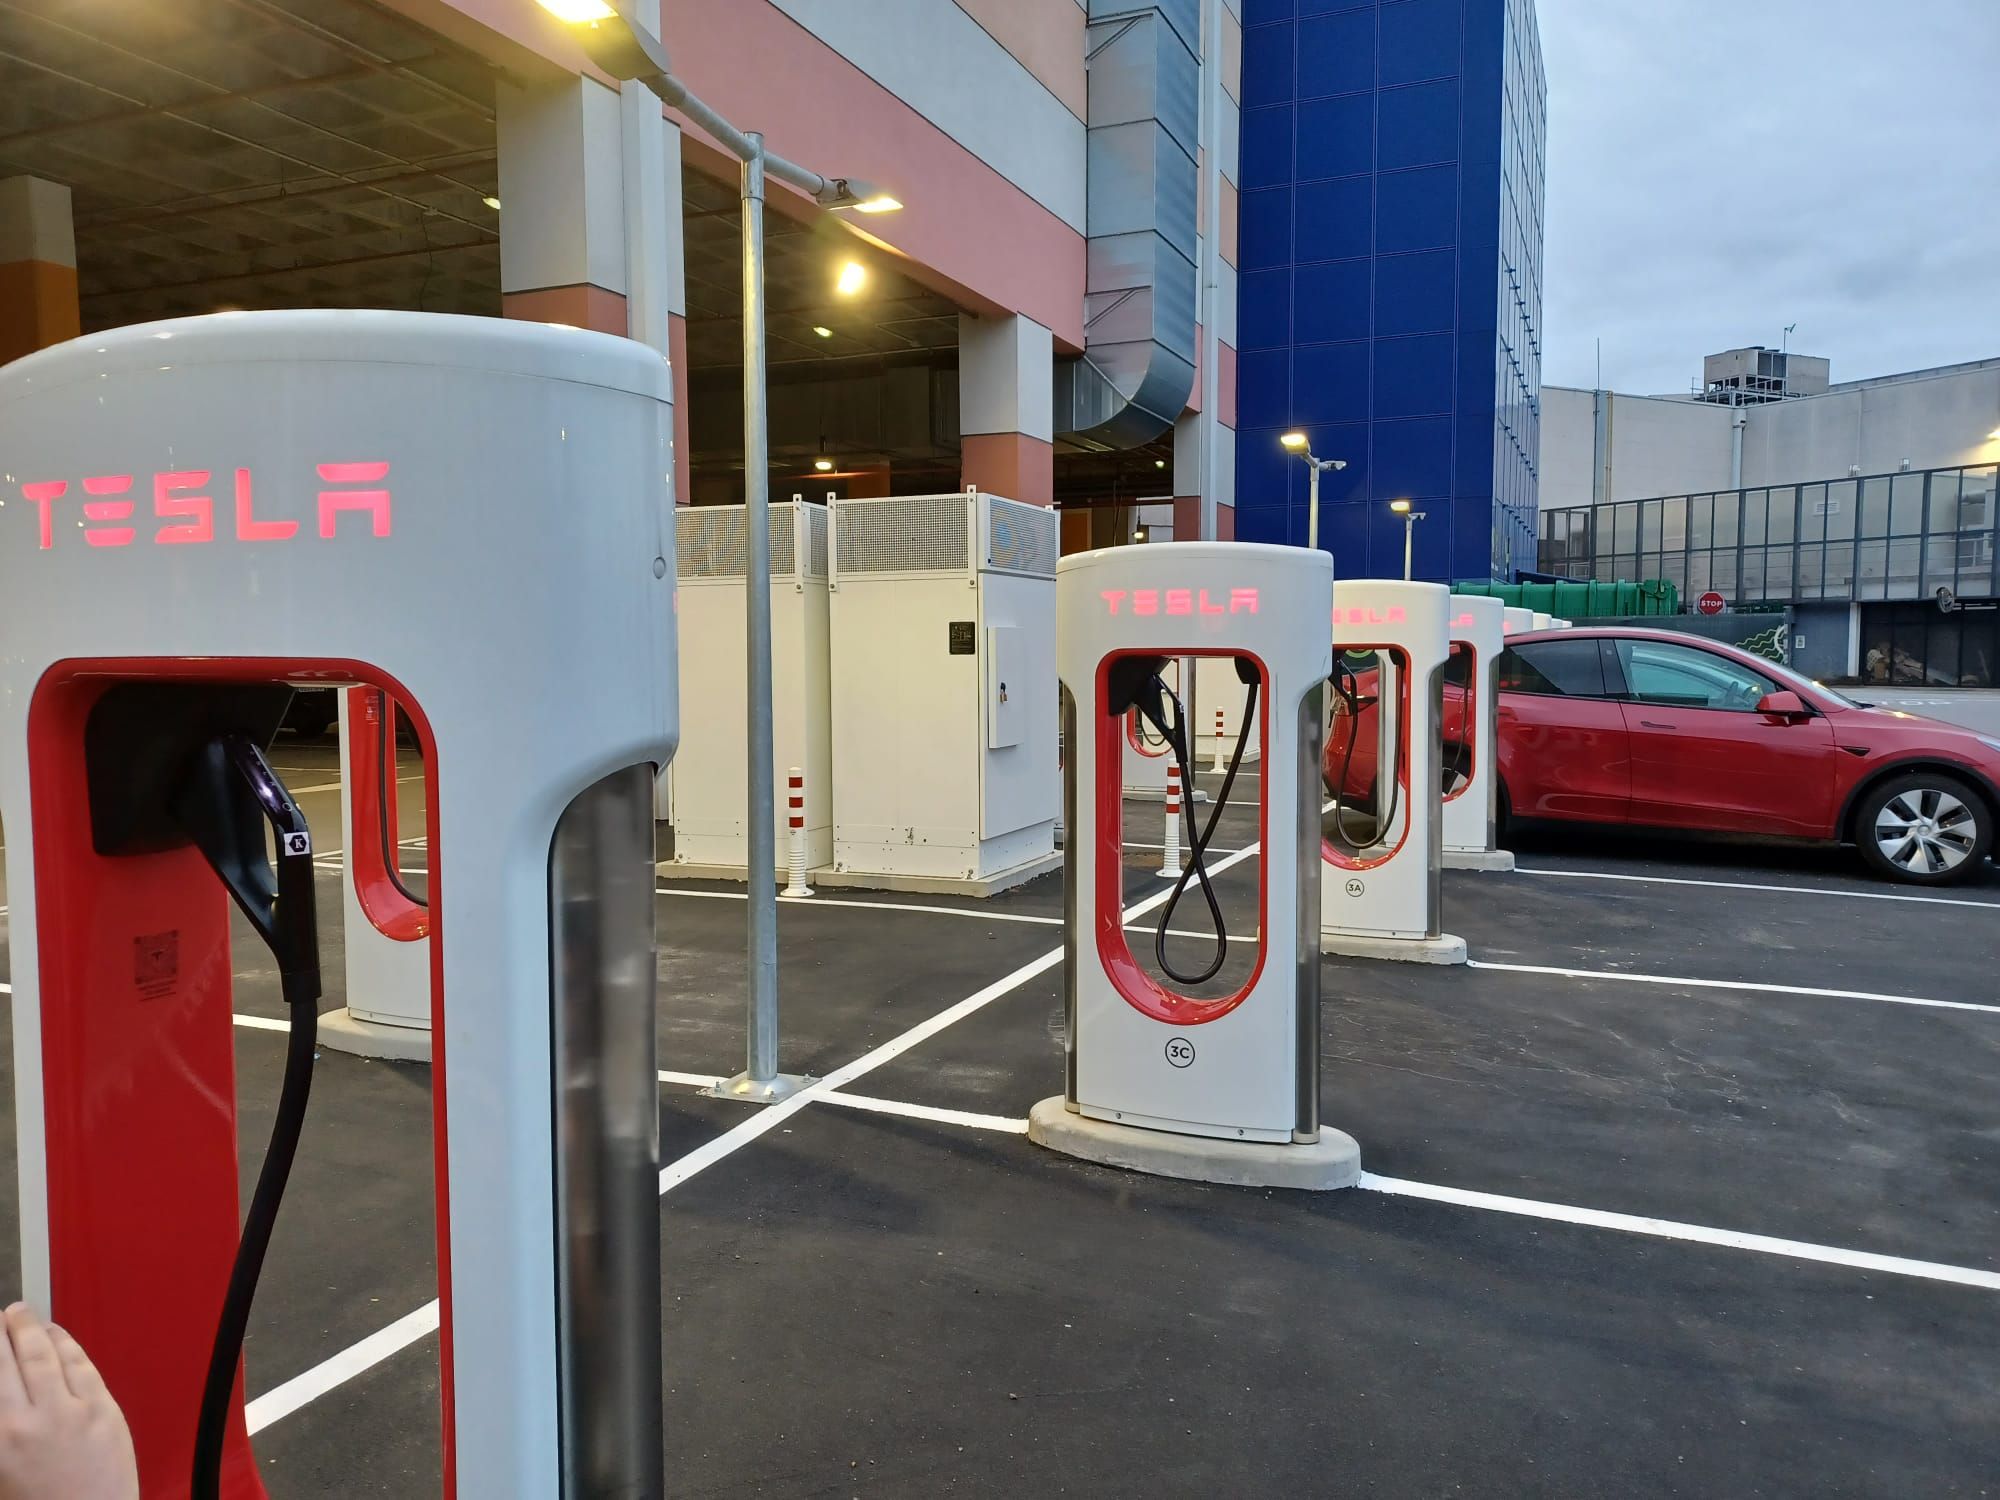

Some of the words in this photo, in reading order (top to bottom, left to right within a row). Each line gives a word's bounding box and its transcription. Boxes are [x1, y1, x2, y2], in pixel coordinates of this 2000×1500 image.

[22, 462, 391, 550] TESLA
[1101, 588, 1259, 616] TESLA
[1332, 607, 1406, 625] ESLA
[294, 838, 304, 849] K
[1170, 1045, 1190, 1059] 3C
